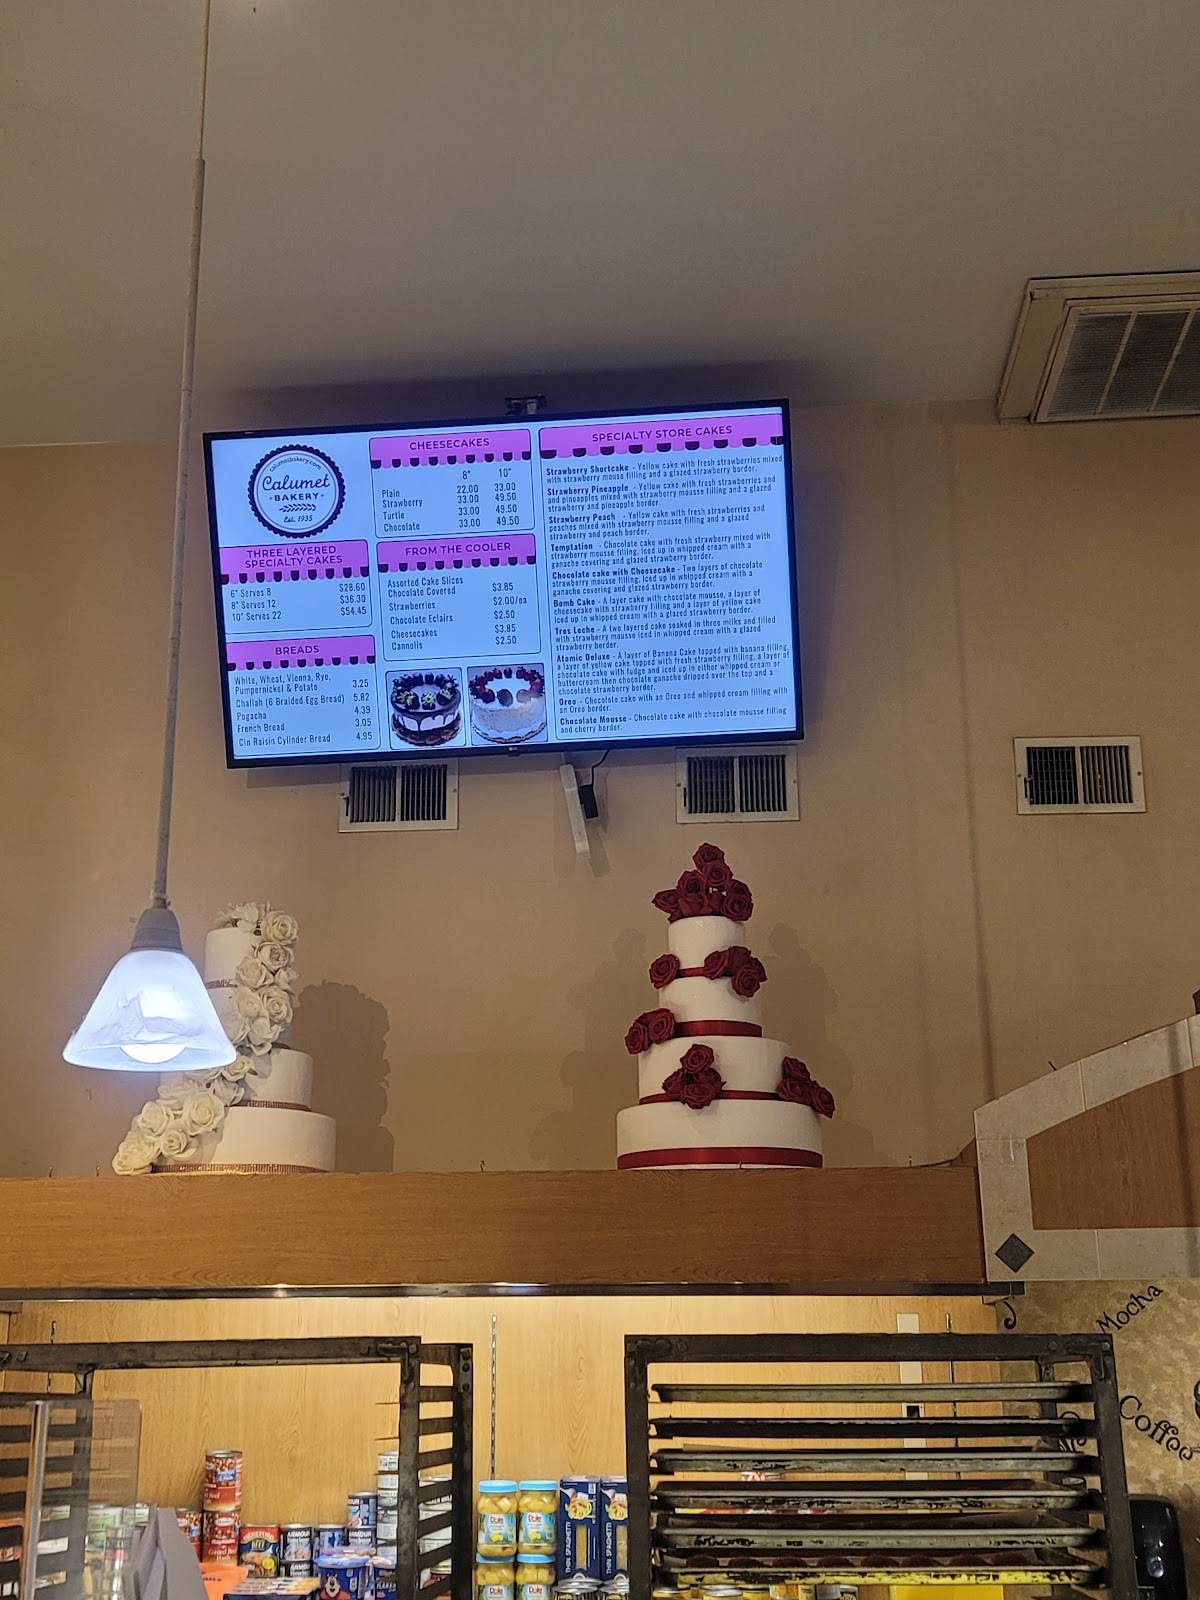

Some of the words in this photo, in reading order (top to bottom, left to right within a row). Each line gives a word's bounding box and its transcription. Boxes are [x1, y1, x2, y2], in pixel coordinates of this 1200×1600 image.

[592, 430, 651, 441] SPECIALTY
[655, 428, 691, 437] STORE
[695, 425, 731, 435] CAKES
[409, 438, 489, 450] CHEESECAKES
[262, 474, 330, 491] Calumet
[381, 489, 399, 498] Plain
[456, 484, 478, 494] 22.00
[494, 482, 516, 492] 33.00
[274, 492, 318, 501] BAKERY
[382, 497, 422, 510] Strawberry
[457, 494, 478, 503] 33.00
[495, 492, 516, 501] 49.50
[383, 510, 404, 519] Turtle
[458, 506, 479, 515] 33.00
[495, 504, 517, 513] 49.50
[383, 522, 420, 532] Chocolate
[458, 518, 480, 528] 33.00
[496, 516, 519, 526] 49.50
[248, 548, 282, 558] THREE
[286, 545, 336, 556] LAYERED
[405, 546, 439, 556] FROM
[438, 544, 462, 554] THE
[465, 542, 510, 552] COOLER
[244, 557, 305, 568] SPECIALTY
[304, 555, 342, 565] CAKES
[240, 588, 264, 597] Serves
[266, 588, 271, 596] 8
[338, 582, 365, 592] $28.60
[387, 578, 419, 588] Assorted
[421, 577, 439, 586] Cake
[441, 576, 462, 584] Slices
[387, 588, 424, 598] Chocolate
[426, 586, 455, 595] Covered
[492, 582, 513, 592] $3.85
[240, 600, 264, 609] Serves
[267, 599, 275, 608] 12
[339, 594, 366, 604] $36.30
[388, 600, 435, 611] Strawberries
[492, 595, 526, 606] $2.00/ea
[245, 611, 269, 620] Serves
[271, 611, 281, 619] 22
[340, 605, 366, 616] $54.45
[389, 615, 426, 625] Chocolate
[428, 613, 452, 622] Eclairs
[493, 609, 515, 619] $2.50
[390, 628, 436, 638] Cheesecakes
[494, 623, 515, 633] $3.85
[275, 644, 319, 655] BREADS
[391, 641, 422, 650] Cannolis
[495, 635, 516, 645] $2.50
[234, 684, 284, 696] Pumpernickel
[294, 682, 317, 691] Potato
[352, 678, 368, 688] 3.25
[235, 698, 262, 708] Challah
[265, 698, 273, 707] (6
[275, 696, 303, 706] Braided
[305, 695, 318, 706] Egg
[320, 694, 344, 704] Bread)
[353, 692, 369, 702] 5.82
[236, 712, 266, 722] Pogacha
[354, 705, 370, 714] 4.39
[237, 724, 261, 733] French
[263, 723, 284, 731] Bread
[354, 718, 371, 727] 3.05
[238, 738, 250, 747] Cin
[252, 737, 275, 746] Raisin
[277, 735, 306, 746] Cylinder
[309, 734, 330, 743] Bread
[356, 731, 372, 740] 4.95
[1096, 1284, 1163, 1334] Mocha
[1119, 1395, 1194, 1461] Coffee
